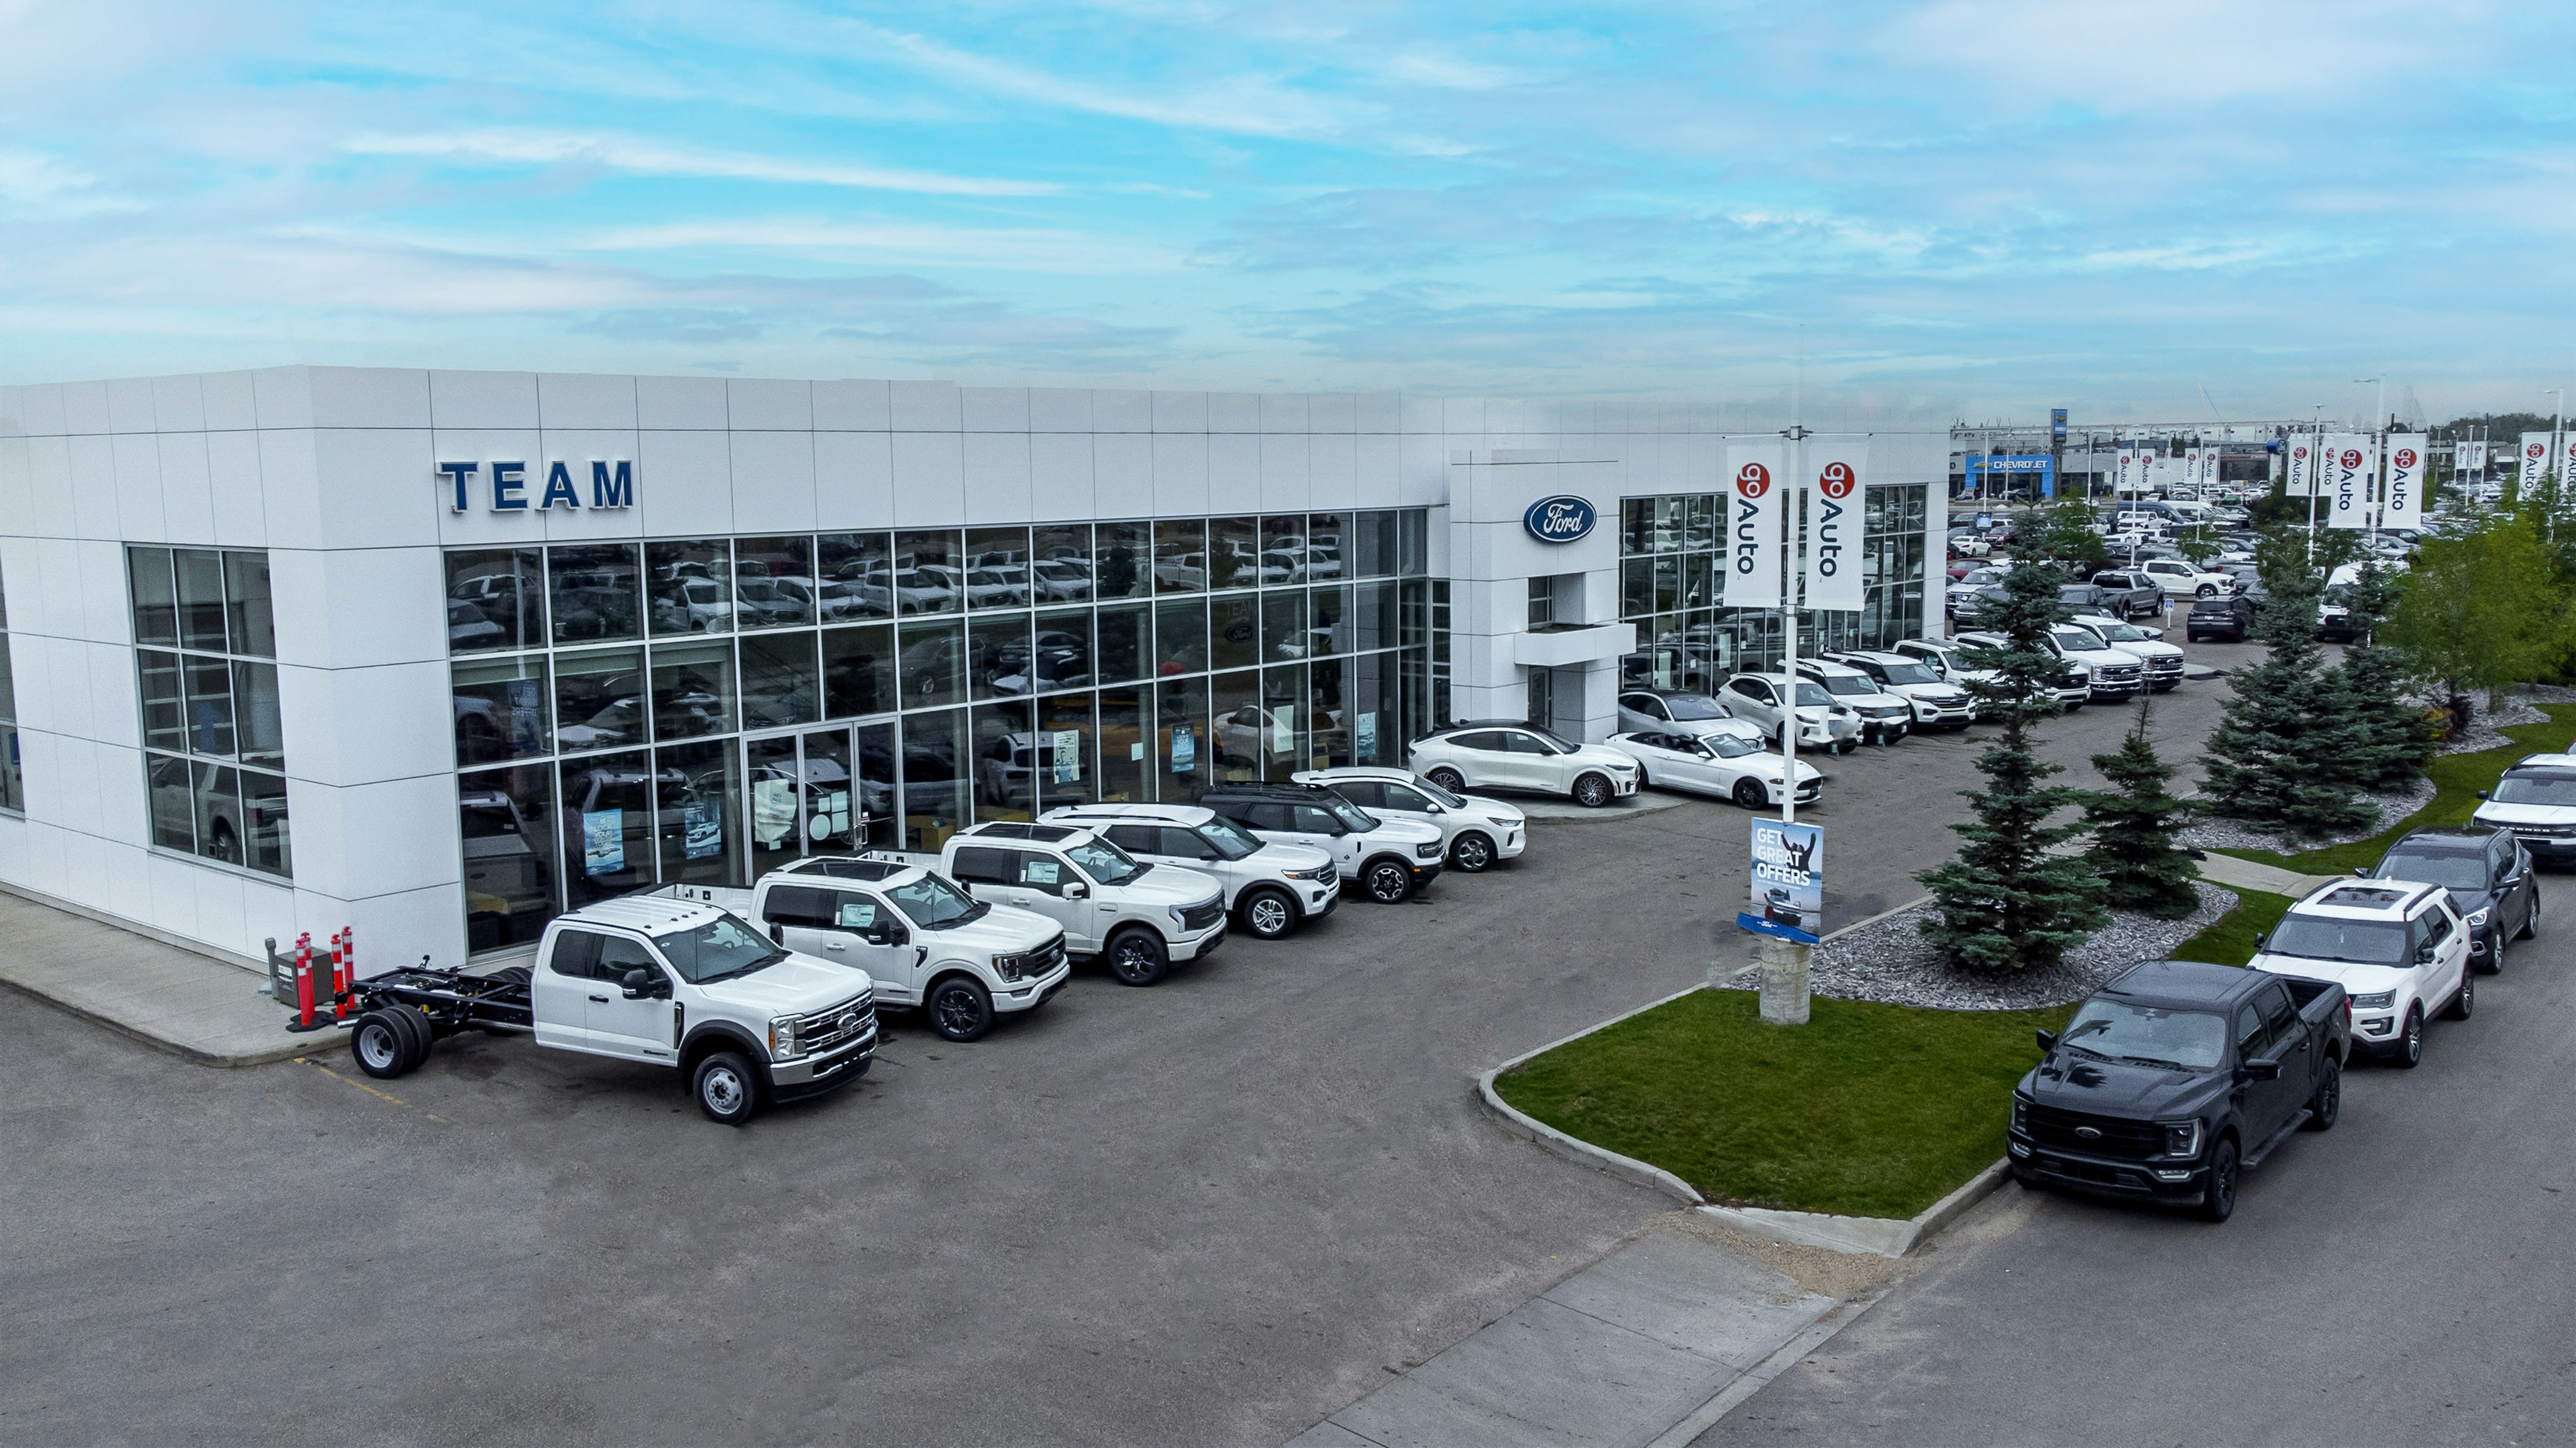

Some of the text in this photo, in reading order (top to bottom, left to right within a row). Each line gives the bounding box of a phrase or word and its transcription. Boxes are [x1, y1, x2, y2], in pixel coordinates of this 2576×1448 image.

[1994, 461, 2047, 469] CHEVROLET
[2292, 459, 2302, 485] Auto
[2325, 459, 2334, 485] Auto
[2339, 451, 2357, 510] go Auto
[2392, 450, 2411, 510] go Auto
[2525, 458, 2538, 489] Auto
[437, 460, 633, 512] TEAM
[1543, 503, 1583, 534] Ford
[1737, 464, 1761, 574] go Auto
[1819, 464, 1845, 577] go Auto
[1757, 827, 1782, 846] GET
[1757, 845, 1803, 866] GREAT
[1756, 863, 1811, 887] OFFERS
